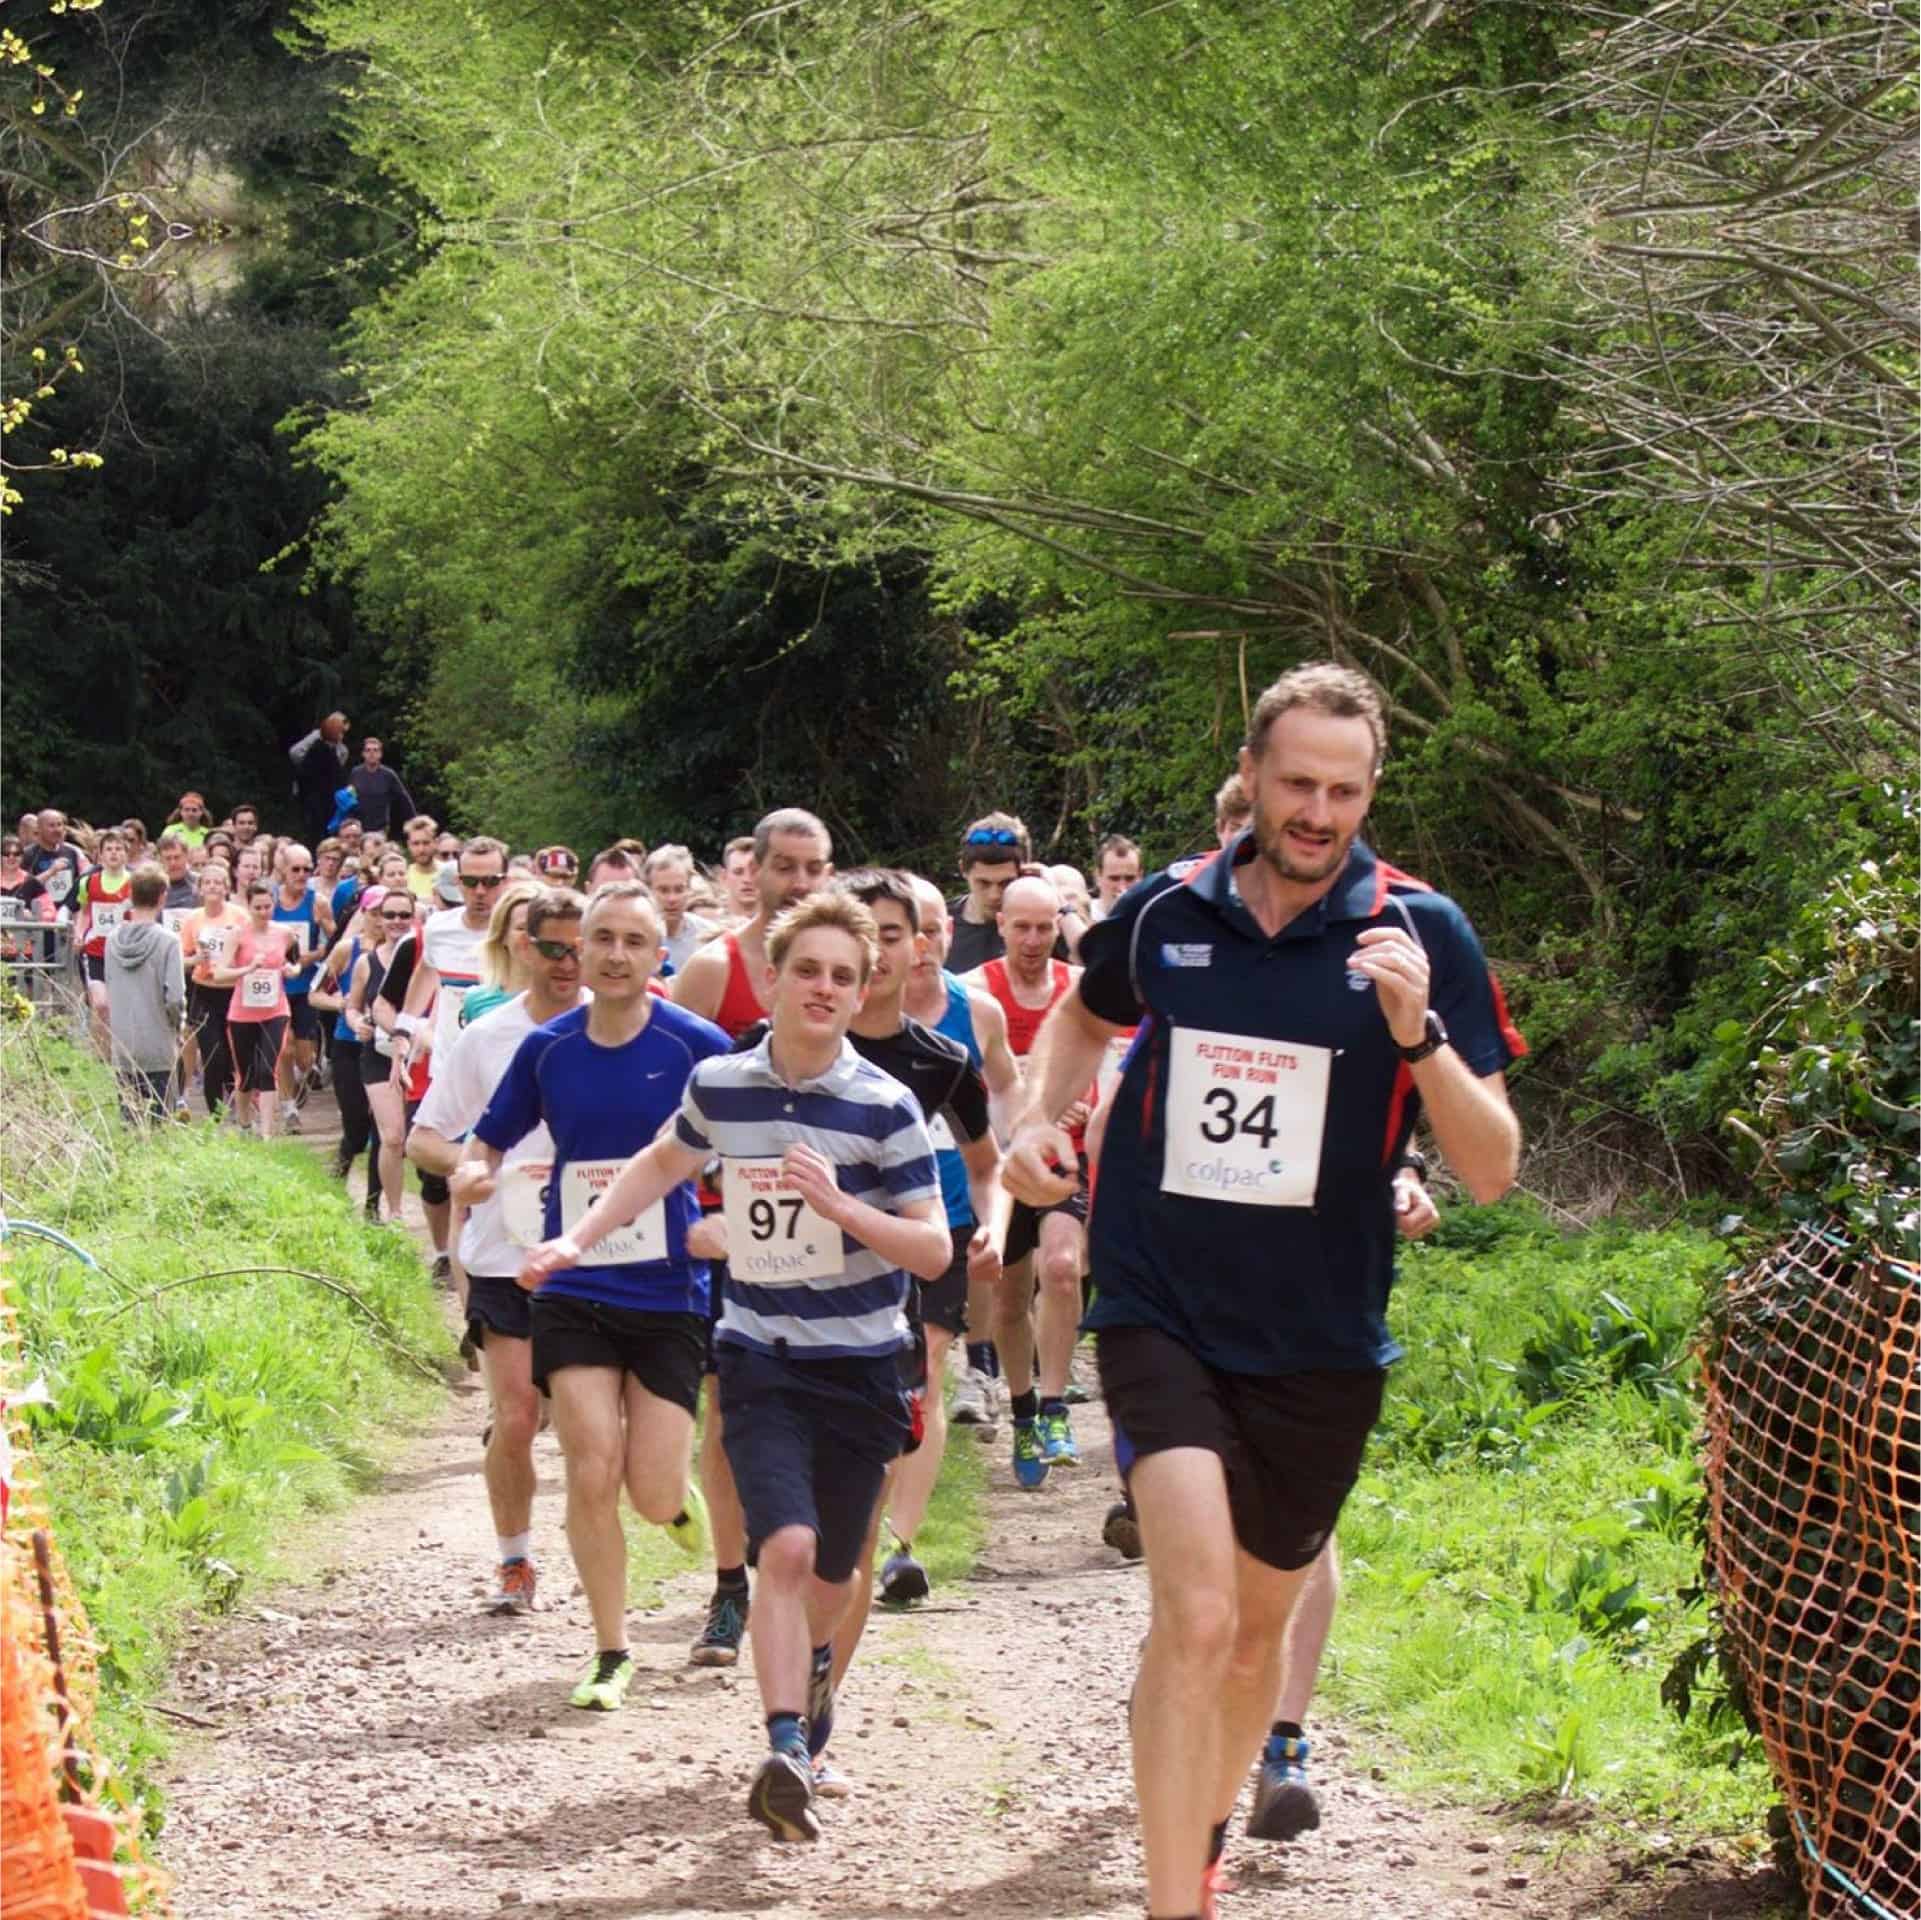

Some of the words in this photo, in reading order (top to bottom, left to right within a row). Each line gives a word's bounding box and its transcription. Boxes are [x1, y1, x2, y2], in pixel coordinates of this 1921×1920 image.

[99, 912, 115, 925] 64
[252, 981, 271, 994] 99
[1197, 1043, 1254, 1063] FLITTON
[1258, 1051, 1298, 1070] FLITS
[1212, 1064, 1241, 1080] FUN
[1247, 1068, 1277, 1084] RUN
[1201, 1087, 1278, 1149] 34
[577, 1167, 614, 1179] FLITTON
[1186, 1157, 1266, 1189] colpac
[749, 1198, 804, 1240] 97
[745, 1249, 806, 1273] colpac
